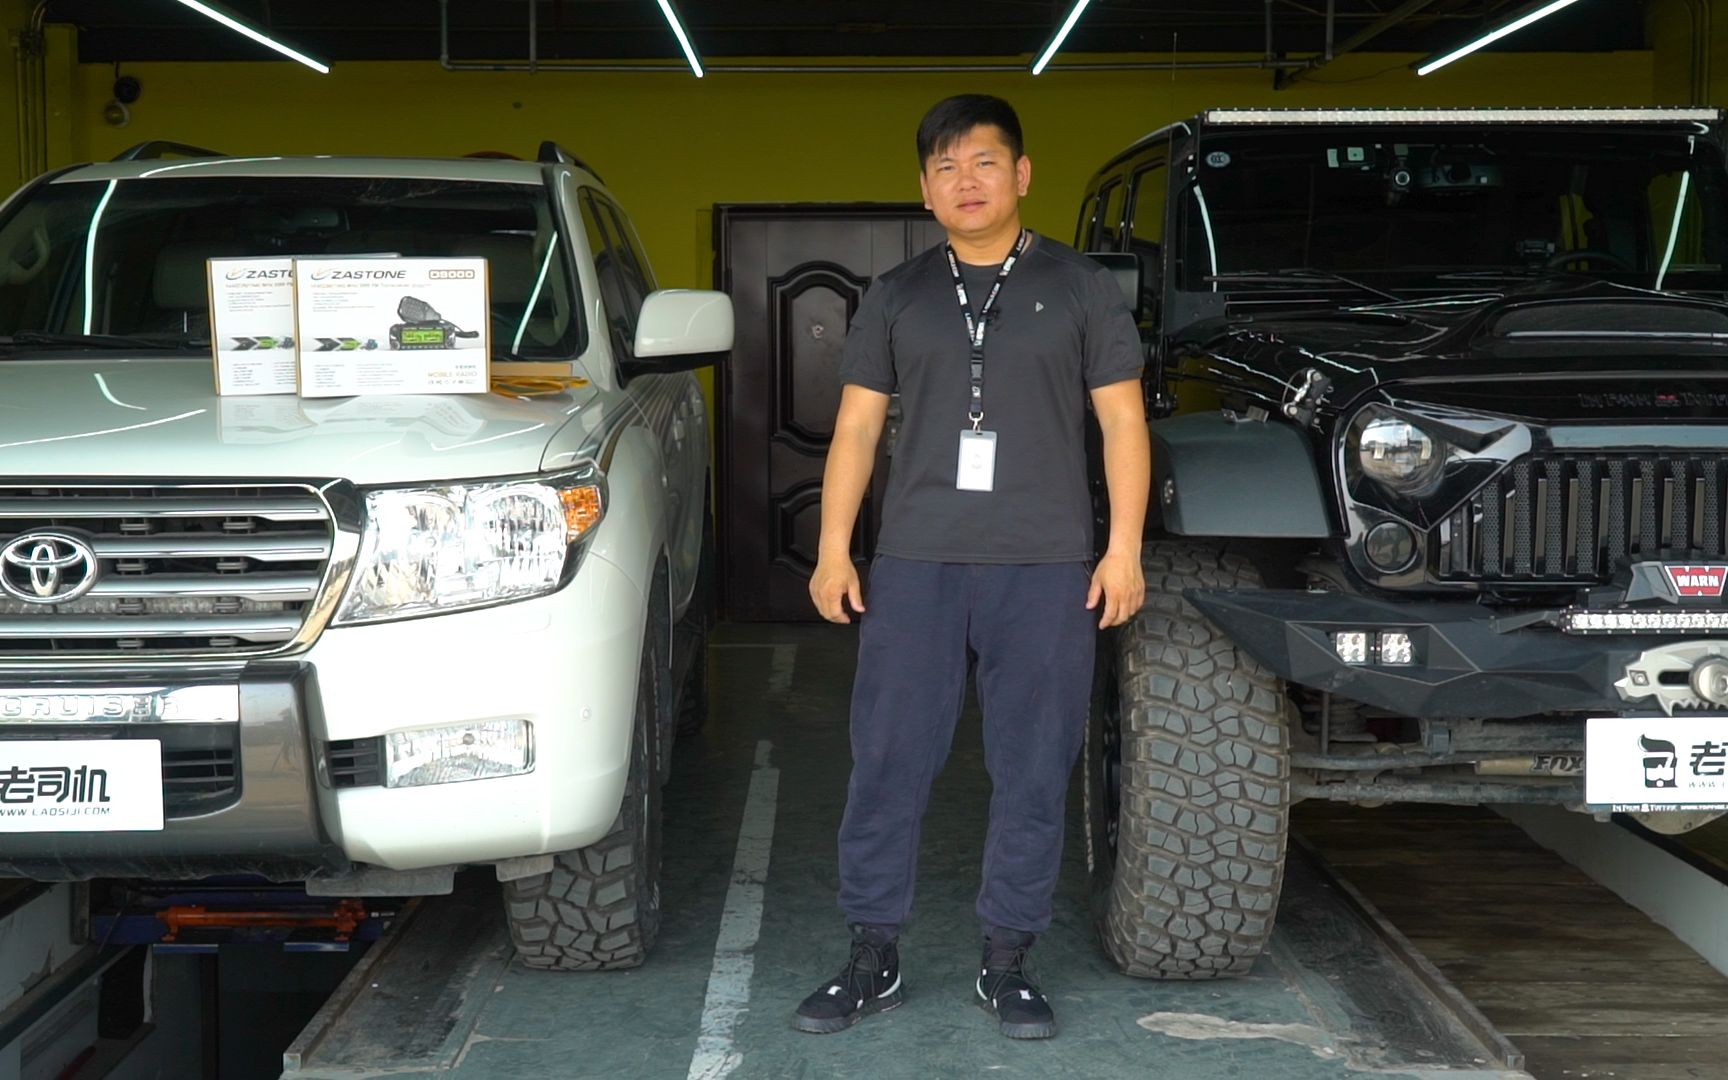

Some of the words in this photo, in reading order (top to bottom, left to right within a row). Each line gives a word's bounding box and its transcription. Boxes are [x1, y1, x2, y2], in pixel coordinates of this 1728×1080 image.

[331, 270, 407, 280] ZASTONE
[1676, 575, 1720, 587] WARN
[1689, 741, 1728, 776] 老
[0, 765, 111, 803] 老司机
